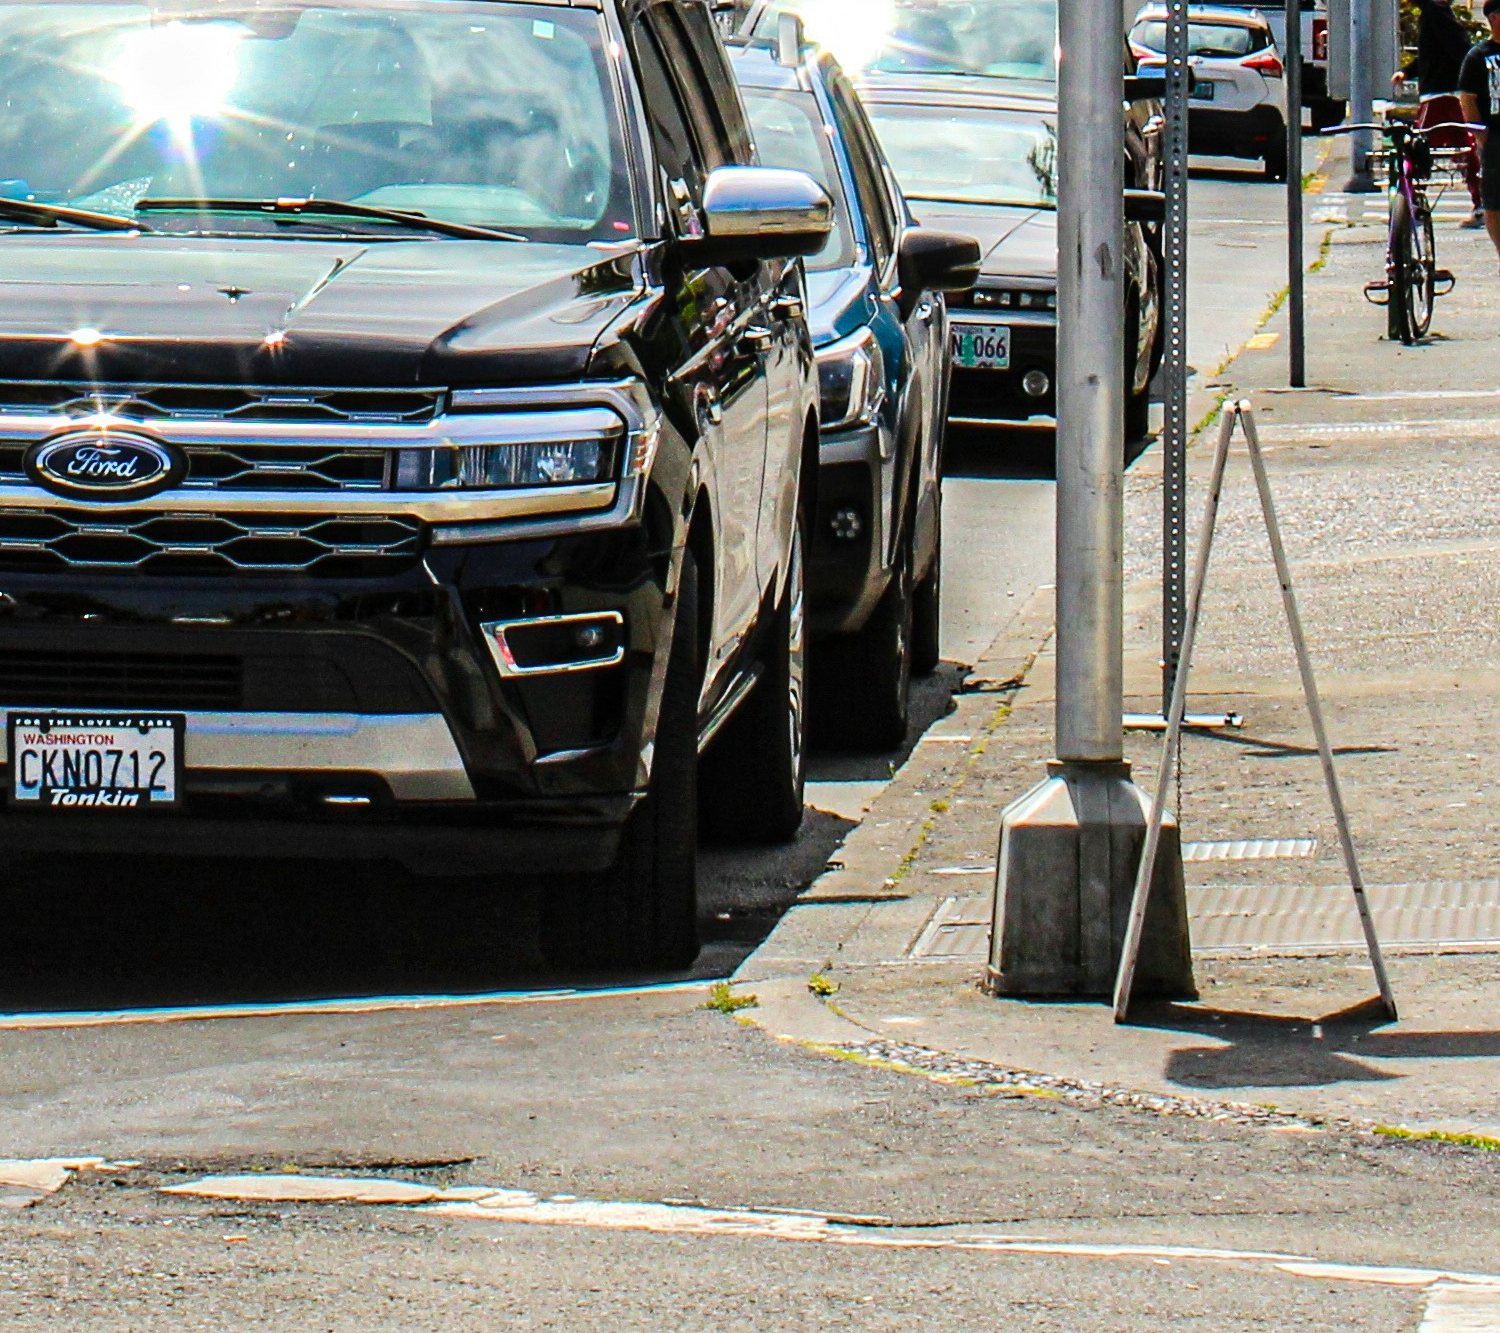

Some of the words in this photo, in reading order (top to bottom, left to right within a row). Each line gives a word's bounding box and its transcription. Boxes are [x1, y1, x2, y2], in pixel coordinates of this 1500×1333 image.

[973, 335, 1006, 358] 066
[67, 447, 138, 477] Ford
[79, 719, 111, 727] LOVE
[139, 719, 172, 727] CARS
[23, 734, 114, 745] WASHINGTON
[50, 788, 140, 806] Tonkin
